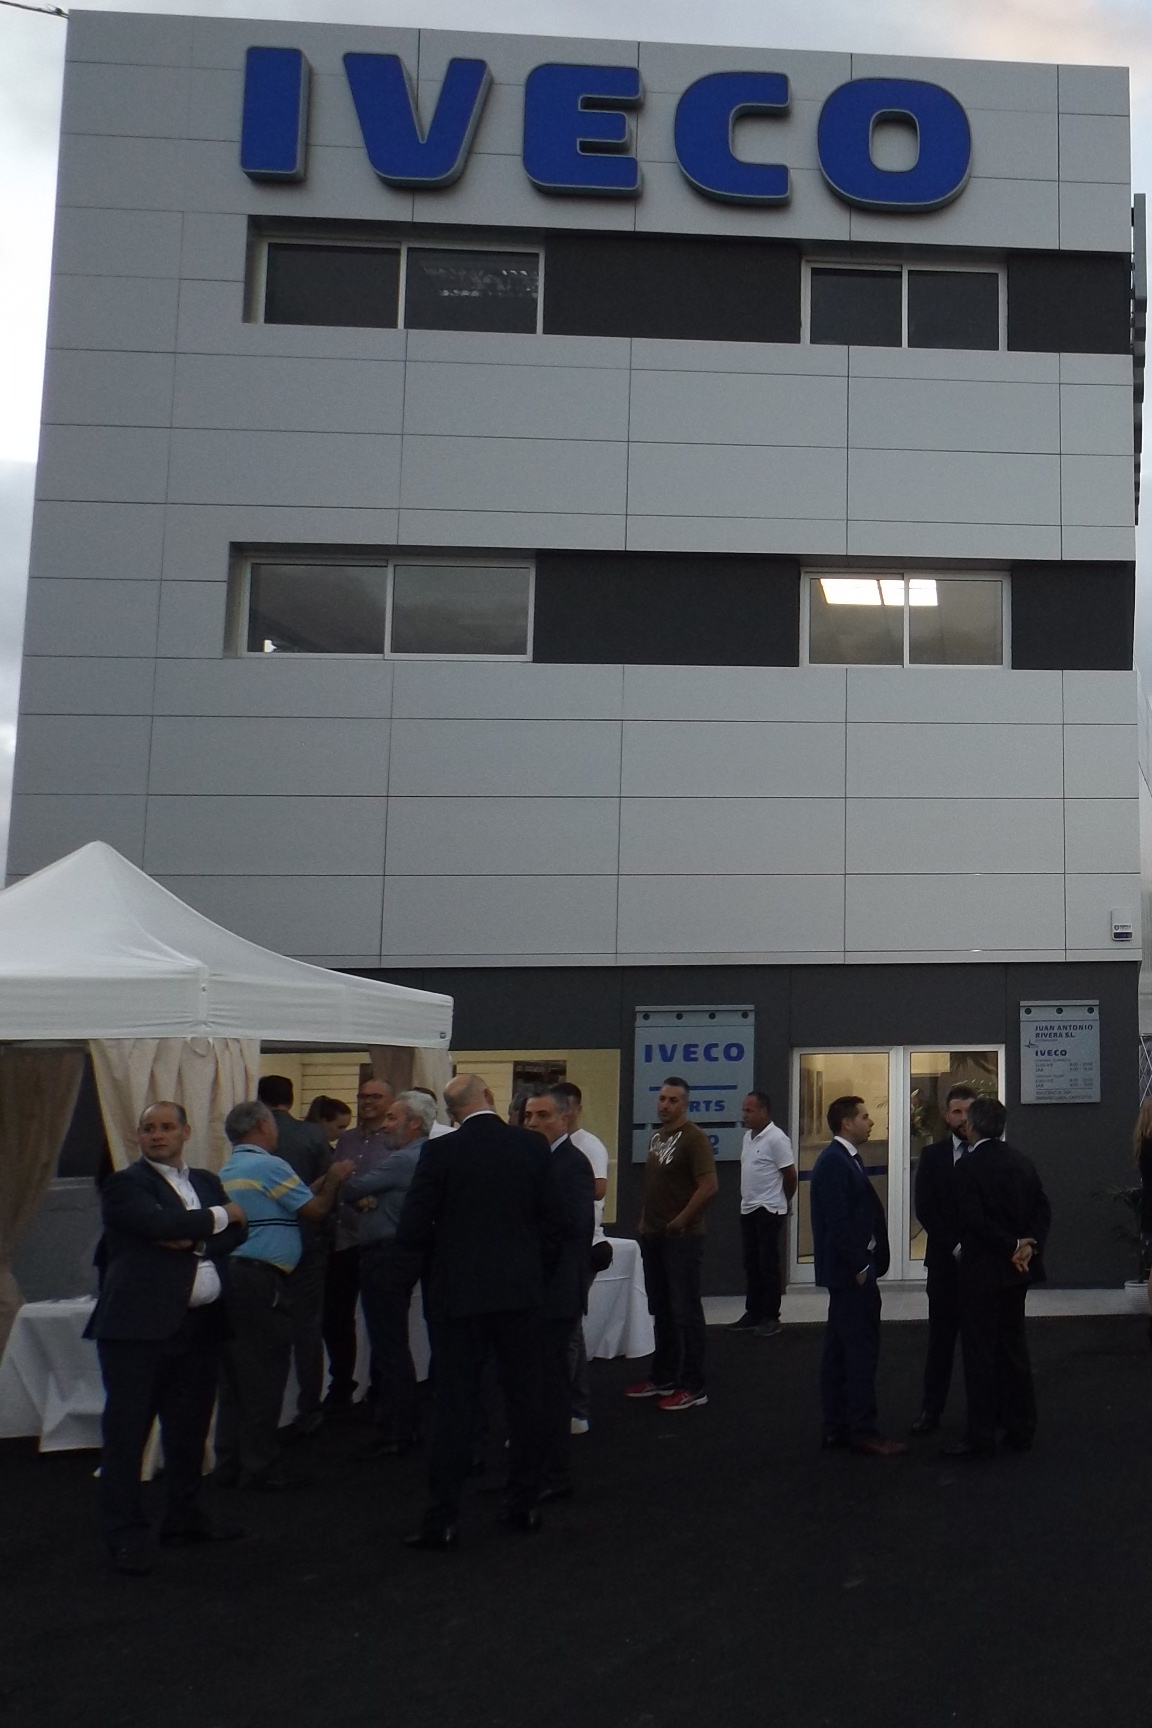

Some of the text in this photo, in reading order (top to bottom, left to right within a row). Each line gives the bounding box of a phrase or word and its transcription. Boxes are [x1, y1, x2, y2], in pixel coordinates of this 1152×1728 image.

[240, 46, 973, 211] IVECO
[644, 1043, 745, 1063] IVECO
[1035, 1049, 1067, 1057] IVECO
[688, 1100, 726, 1112] RTS
